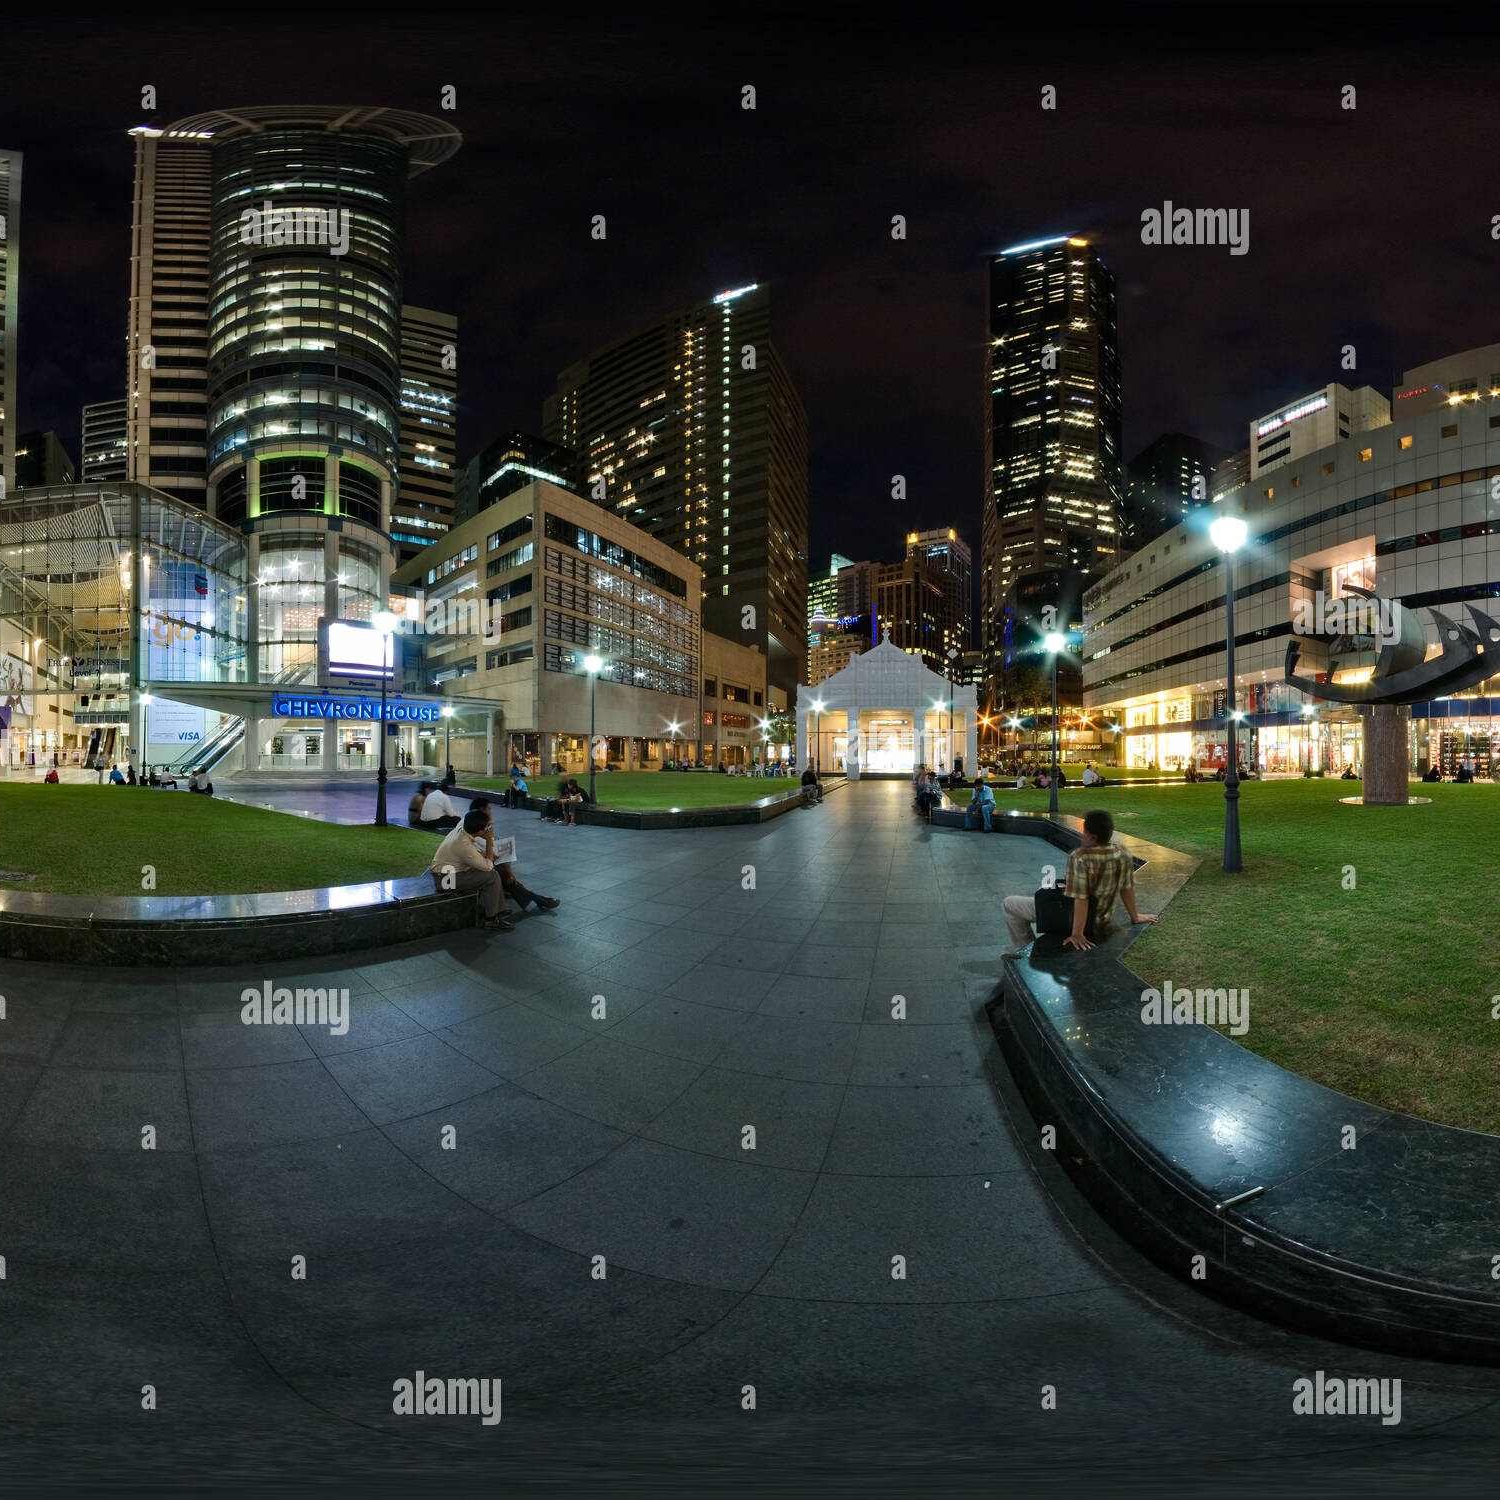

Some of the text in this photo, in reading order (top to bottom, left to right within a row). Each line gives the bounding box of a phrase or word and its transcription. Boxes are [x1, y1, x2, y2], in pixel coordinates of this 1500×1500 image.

[1397, 387, 1427, 399] FORTIS
[837, 616, 859, 625] ASCOTT
[275, 700, 439, 722] CHEVRON HOUSE
[178, 731, 200, 741] VISA
